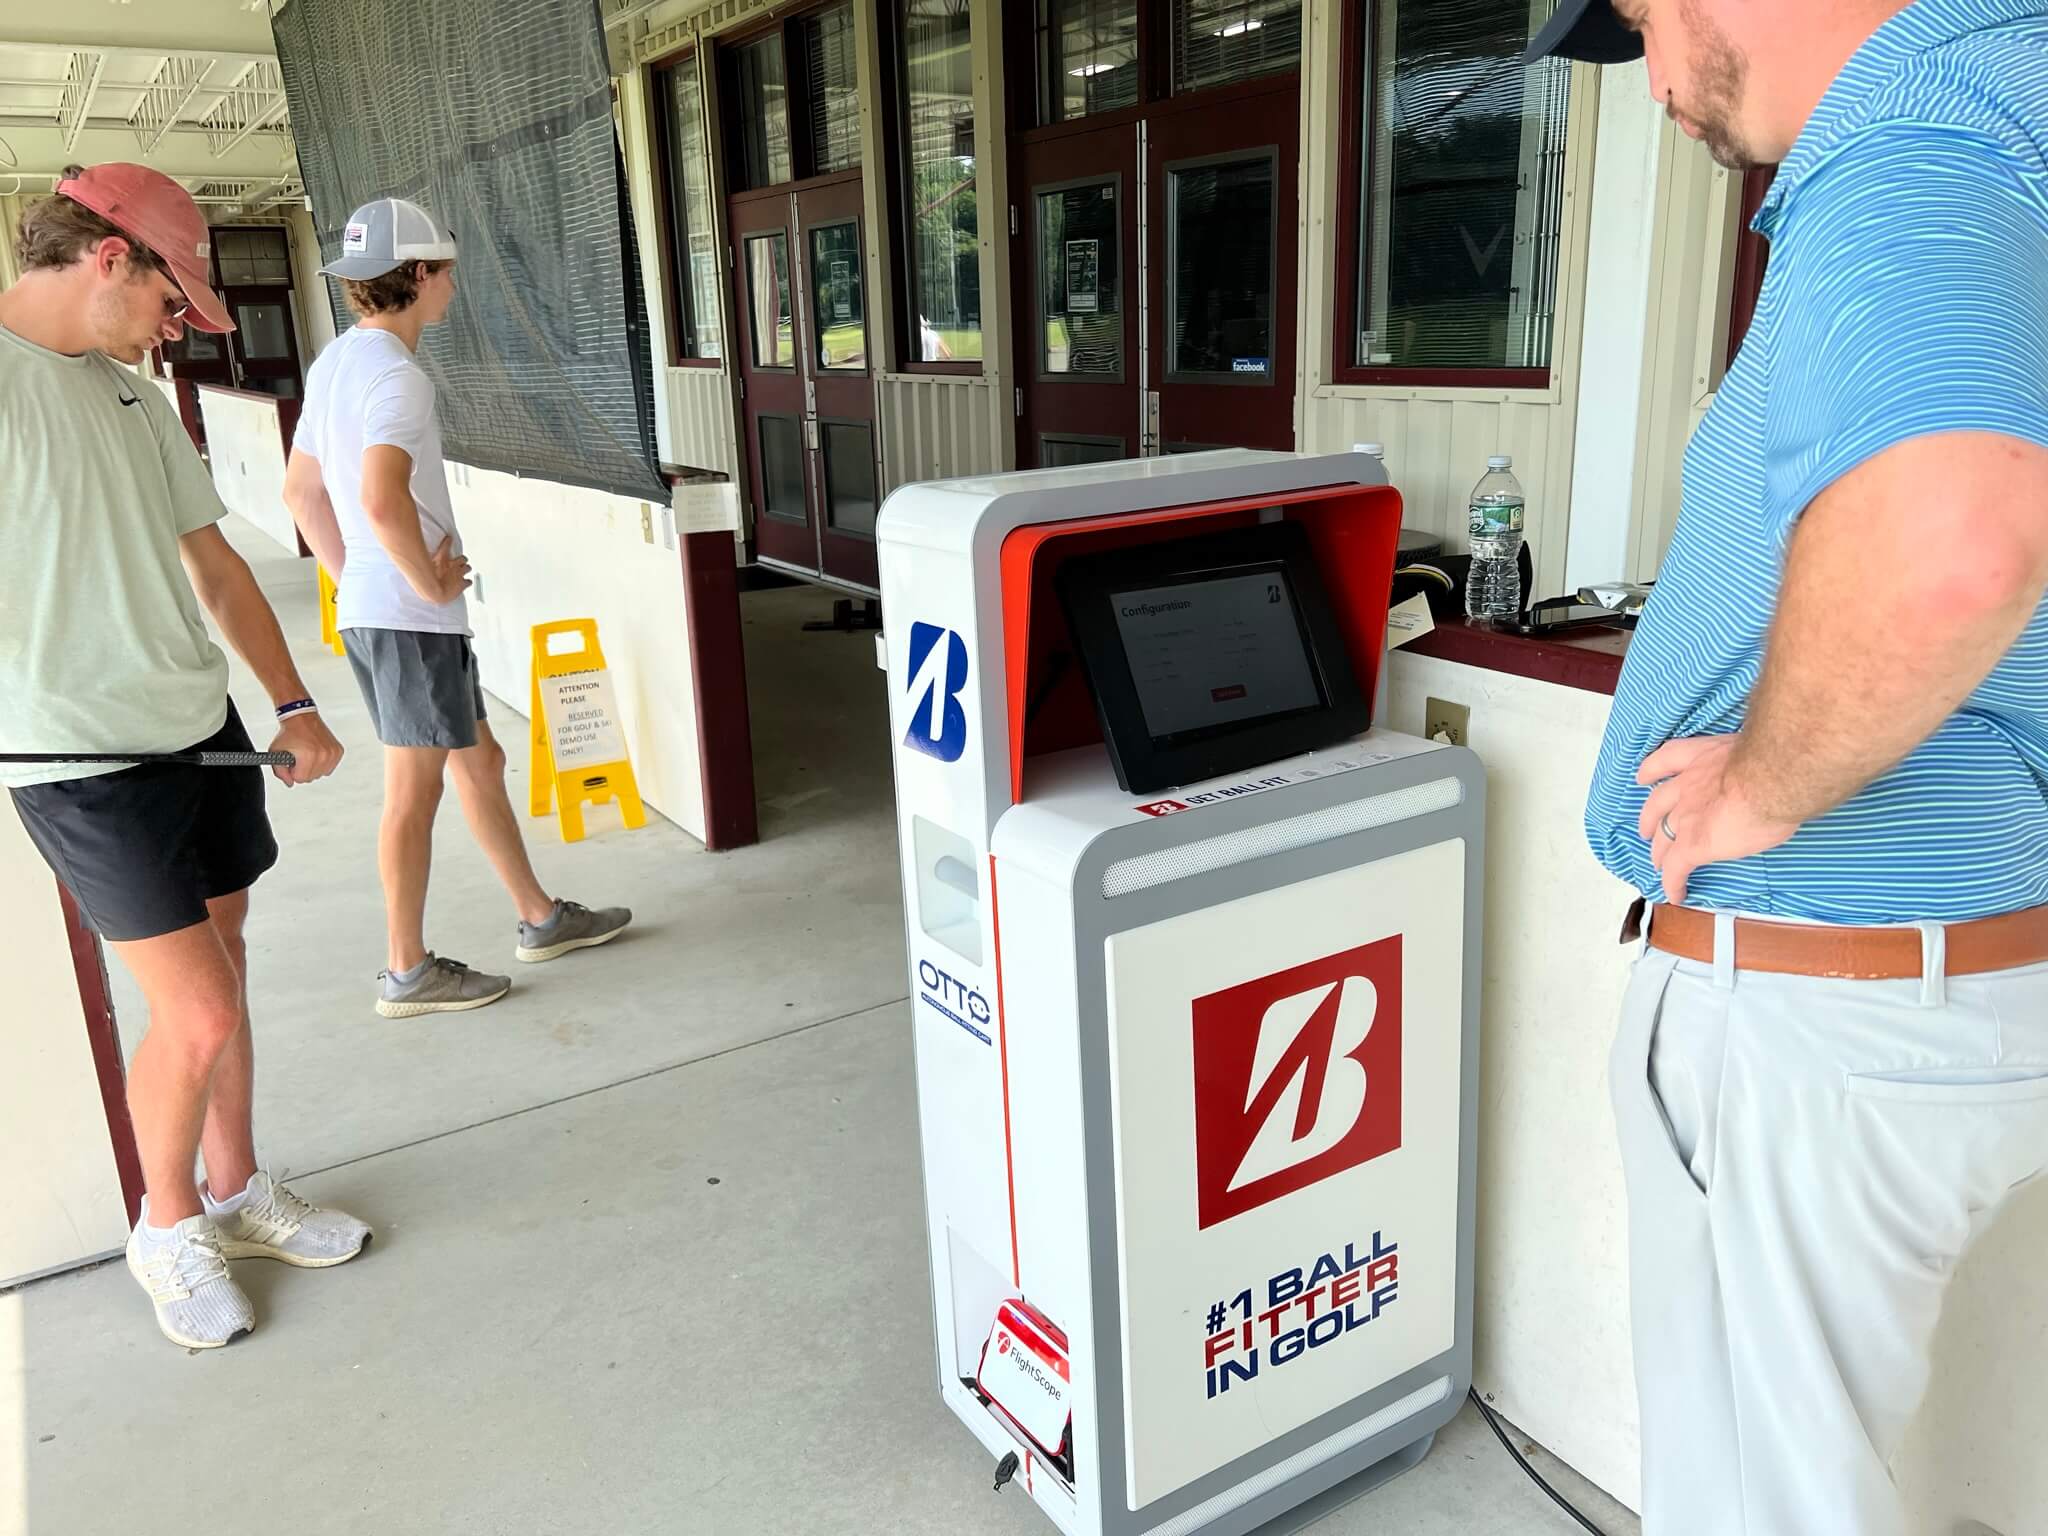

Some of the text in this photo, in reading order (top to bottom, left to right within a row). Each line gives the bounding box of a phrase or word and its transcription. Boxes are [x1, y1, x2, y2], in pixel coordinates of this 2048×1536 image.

[1233, 361, 1265, 372] facebook
[1121, 599, 1192, 618] Configuration
[559, 682, 600, 694] ATTENTION
[561, 695, 586, 705] PLEASE
[568, 709, 604, 722] RESERVED
[558, 726, 573, 735] FOR
[574, 723, 592, 732] GOLF
[560, 733, 597, 746] DEMO USE
[1185, 792, 1221, 805] GET
[1217, 783, 1267, 797] BALL
[1259, 776, 1291, 787] FIT
[920, 959, 991, 1025] OTTO
[1206, 1230, 1398, 1336] #1 BALL
[1205, 1254, 1398, 1369] FITTER
[1206, 1281, 1398, 1400] IN GOLF
[1010, 1346, 1061, 1401] FlightScope
